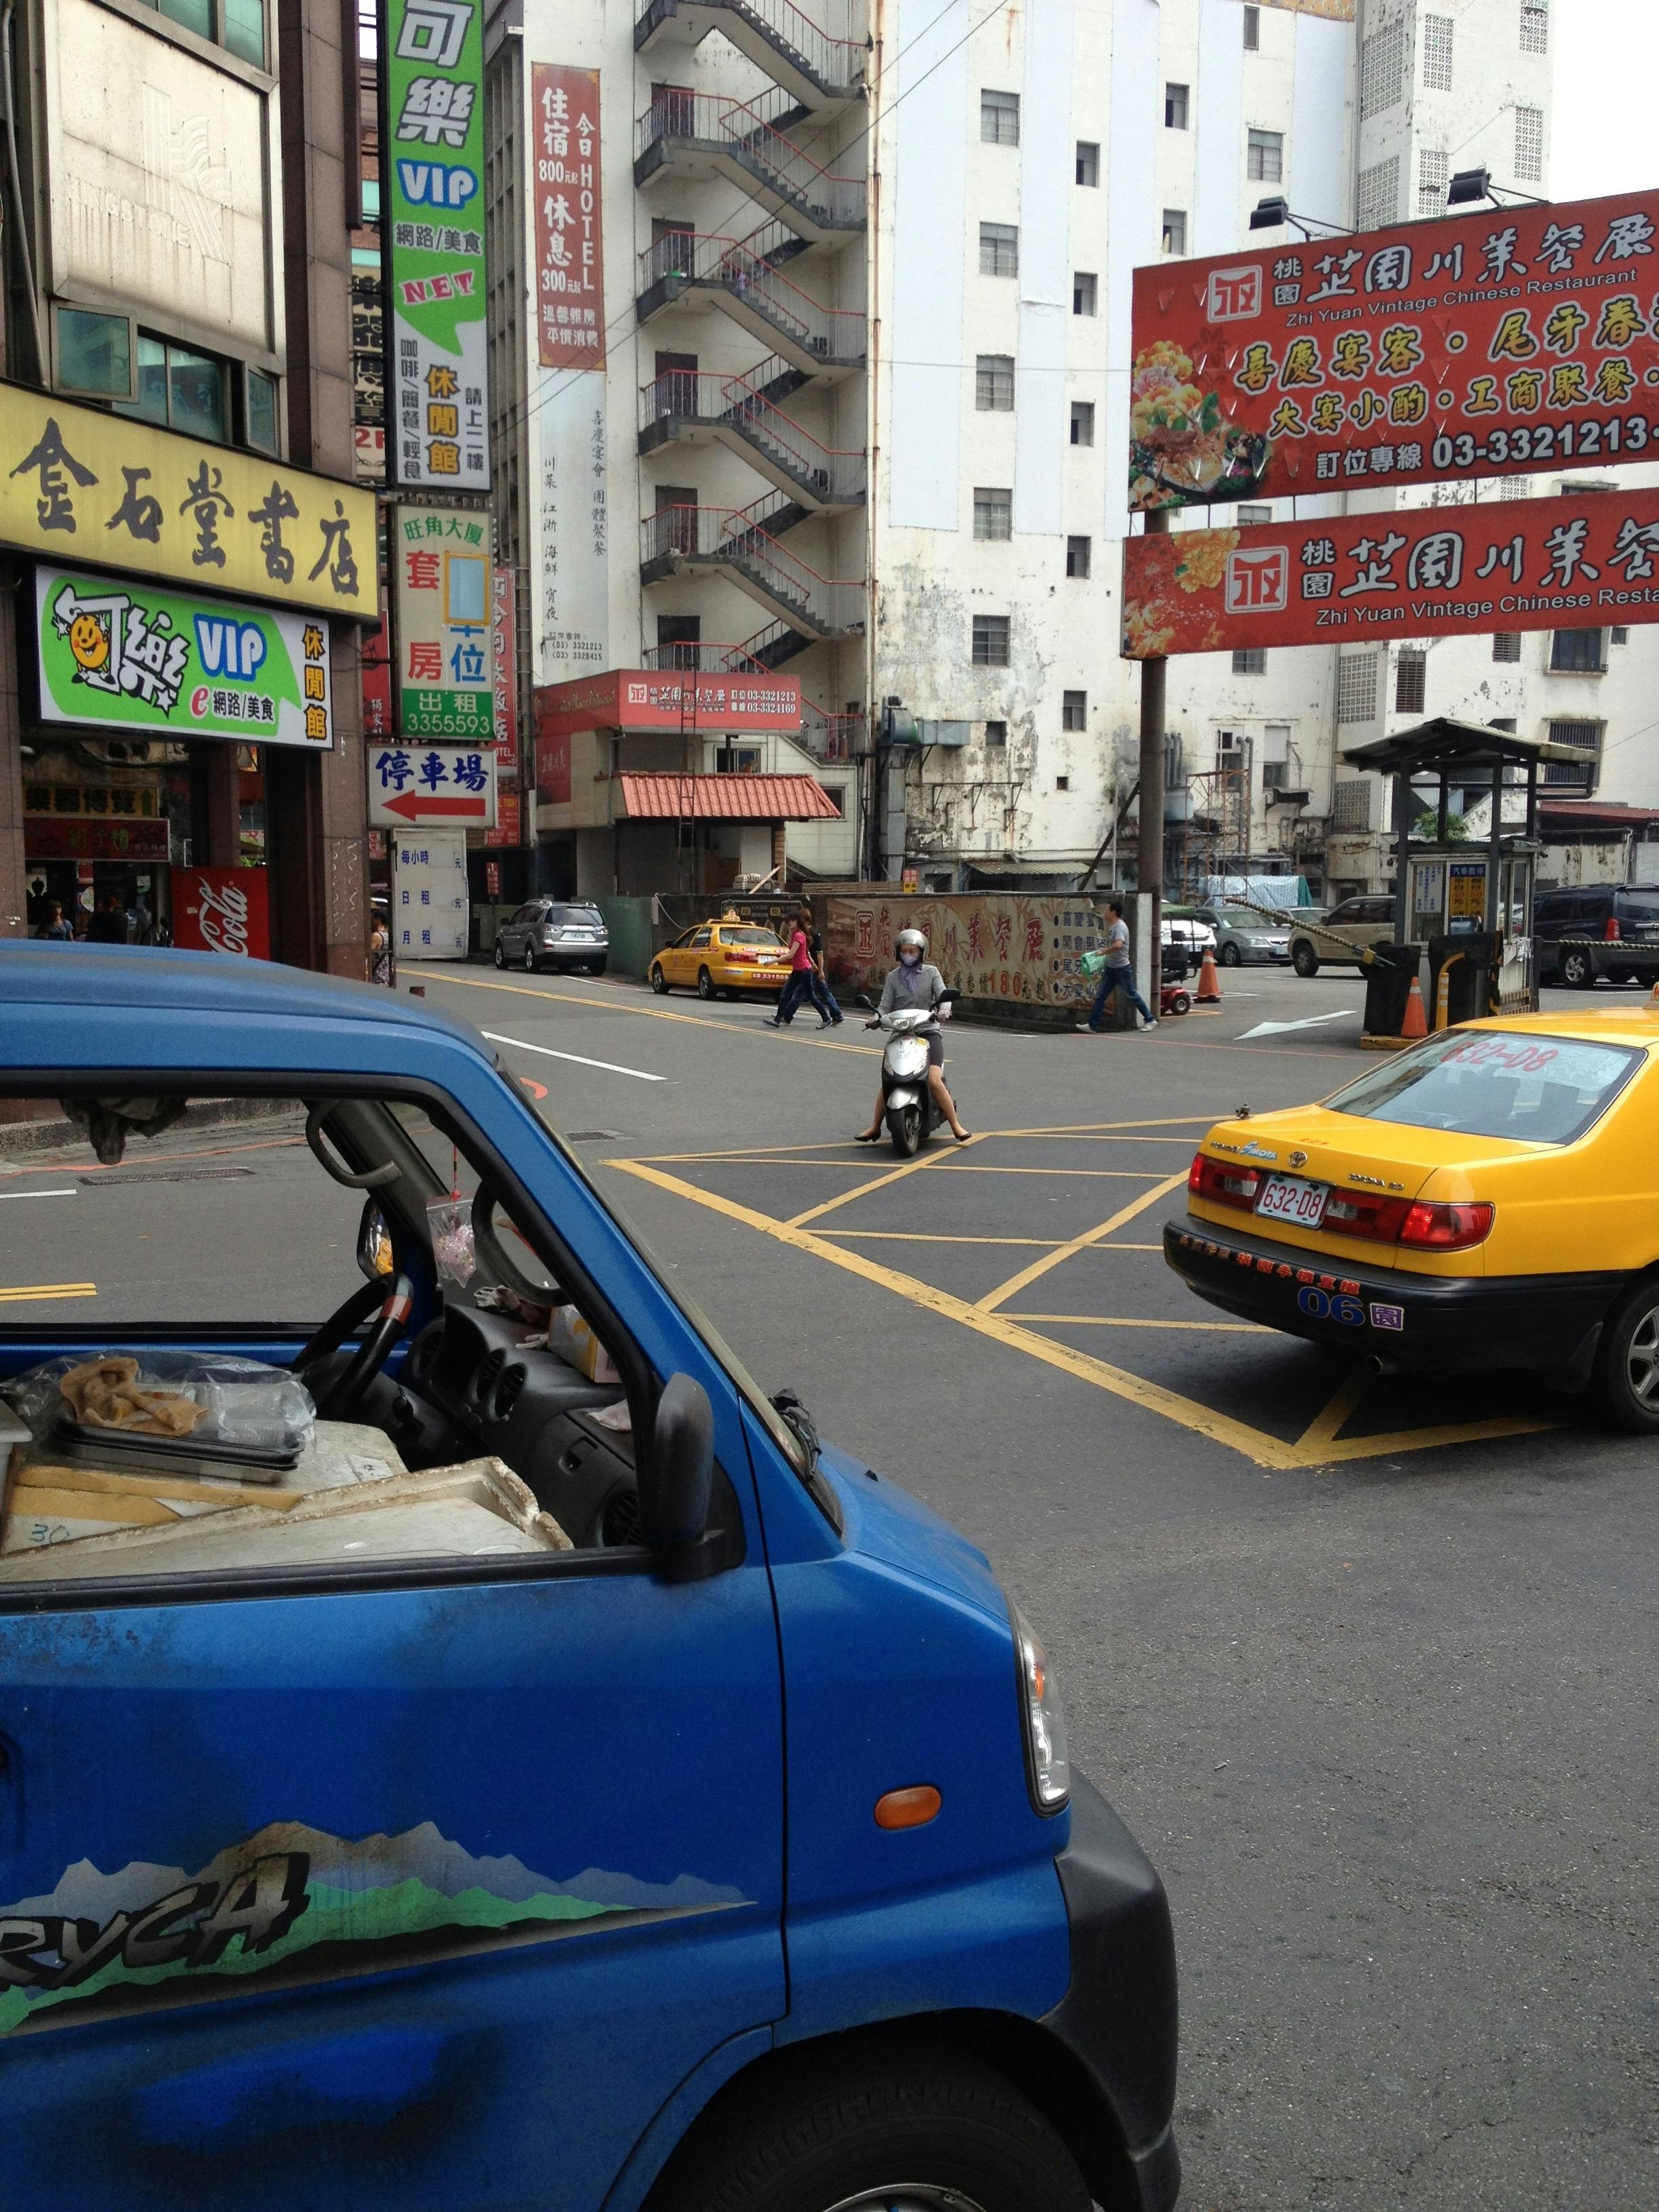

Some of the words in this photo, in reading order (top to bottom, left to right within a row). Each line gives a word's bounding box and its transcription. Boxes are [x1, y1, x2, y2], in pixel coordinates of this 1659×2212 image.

[395, 0, 476, 149] 可樂
[541, 86, 570, 158] 住宿
[575, 112, 596, 158] 今日
[398, 161, 477, 208] VIP
[396, 222, 482, 255] 網路/美食
[544, 194, 576, 267] 休息
[580, 163, 595, 291] HOTEL
[1305, 213, 1657, 305] 芷園川菜餐廳
[402, 271, 474, 304] NET
[1273, 258, 1302, 306] 桃園
[1286, 310, 1313, 327] Zhi
[1318, 305, 1363, 323] Yuan
[1368, 295, 1438, 316] Vintage
[1443, 286, 1521, 307] Chinese
[1527, 268, 1637, 295] Restaurant
[547, 327, 599, 348] 平價消費
[1237, 325, 1421, 389] 喜慶宴客
[1493, 297, 1659, 359] 尾牙春
[1270, 387, 1427, 437] 大宴小酌
[1465, 359, 1634, 413] 工商聚餐
[466, 387, 484, 470] 請上二樓
[591, 409, 606, 478] 喜慶宴會
[1316, 443, 1422, 478] 訂位專線
[1432, 416, 1648, 469] 03-3321213
[544, 457, 558, 490] 川菜
[9, 417, 360, 597] 金石堂書店
[544, 504, 558, 533] 江浙
[591, 489, 607, 557] 團體聚餐
[403, 516, 485, 546] 旺角大廈
[544, 544, 558, 577] 海鮮
[1301, 539, 1335, 598] 桃園
[405, 550, 443, 681] 套房
[545, 588, 559, 621] 宵夜
[1317, 609, 1348, 626] Zhi
[1354, 606, 1405, 622] Yuan
[1412, 598, 1494, 619] Vintage
[1500, 592, 1591, 613] Chinese
[194, 614, 268, 682] VIP
[573, 641, 602, 651] 3321213
[302, 623, 328, 741] 休閒館
[419, 692, 478, 714] 出租
[747, 689, 796, 701] 03-3321213
[213, 691, 275, 722] 網路/美食
[407, 713, 491, 735] 3355593
[747, 702, 796, 714] 03-3324169
[375, 750, 489, 792] 停車場
[401, 850, 430, 865] 每小時
[455, 858, 462, 869] 元
[402, 890, 431, 906] 日租
[454, 898, 462, 909] 元
[402, 930, 431, 945] 月租
[455, 938, 463, 948] 元
[1441, 1041, 1559, 1072] 632-D8
[1297, 1286, 1366, 1326] 06
